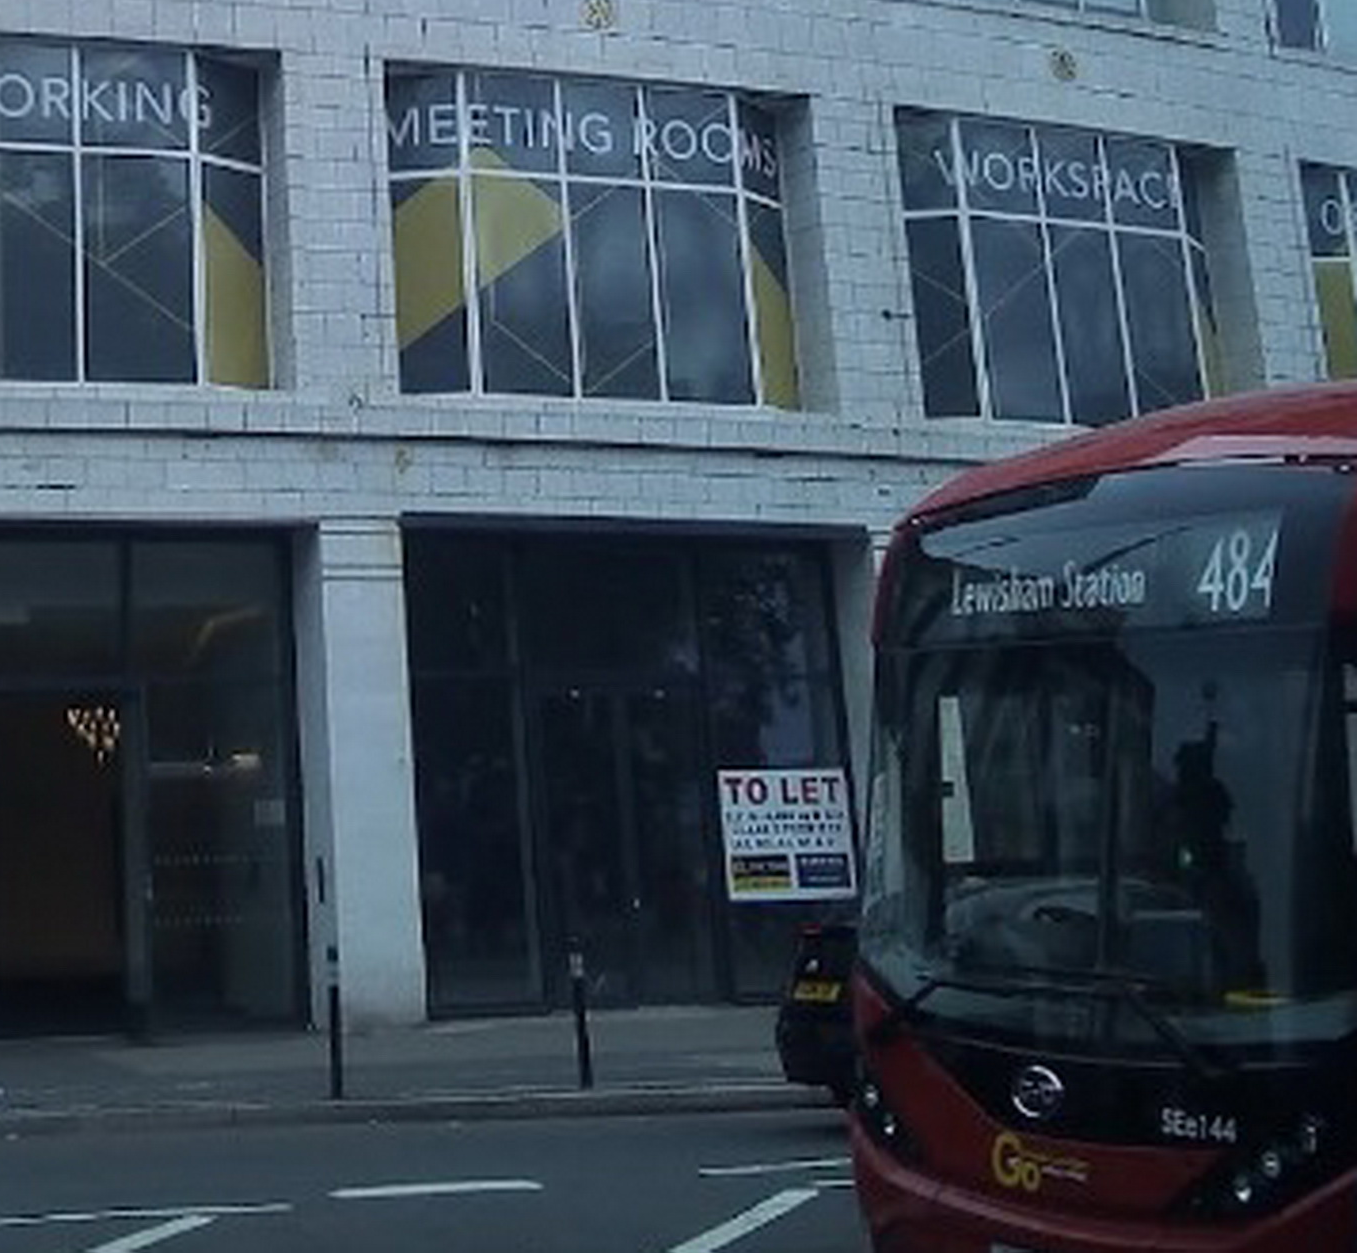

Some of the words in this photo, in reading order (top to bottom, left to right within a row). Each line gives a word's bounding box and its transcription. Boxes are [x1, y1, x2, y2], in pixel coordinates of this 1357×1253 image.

[385, 103, 613, 153] MEETING
[633, 118, 777, 179] ROOMS
[951, 565, 1055, 616] Lewisham
[1061, 560, 1145, 609] Station
[1196, 526, 1279, 612] 484
[723, 776, 768, 806] TO
[780, 775, 840, 805] LET
